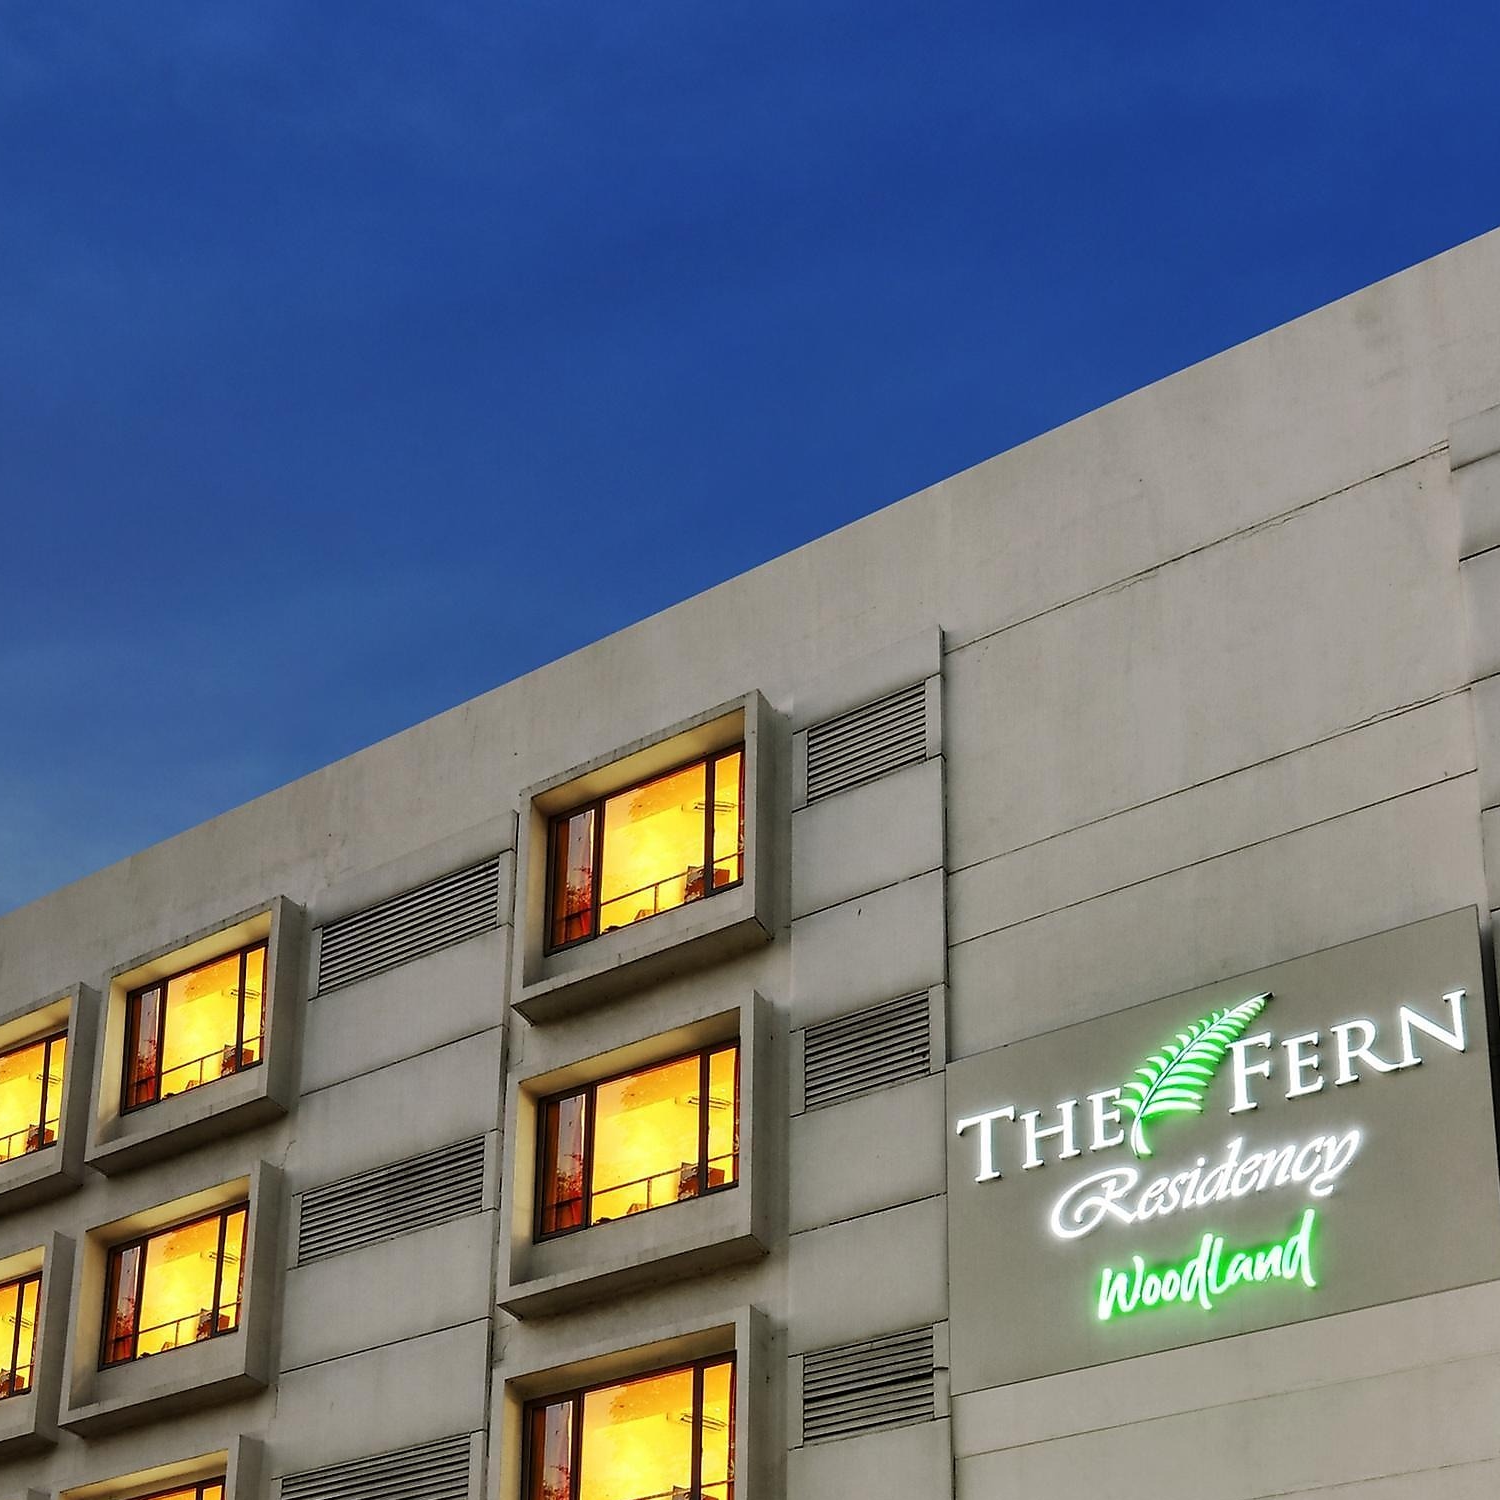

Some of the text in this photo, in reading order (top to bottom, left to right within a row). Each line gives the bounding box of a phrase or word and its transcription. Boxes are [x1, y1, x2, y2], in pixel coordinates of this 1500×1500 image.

[956, 988, 1468, 1183] THE FERN
[1050, 1127, 1362, 1239] Residency
[1096, 1208, 1318, 1321] Woodland
